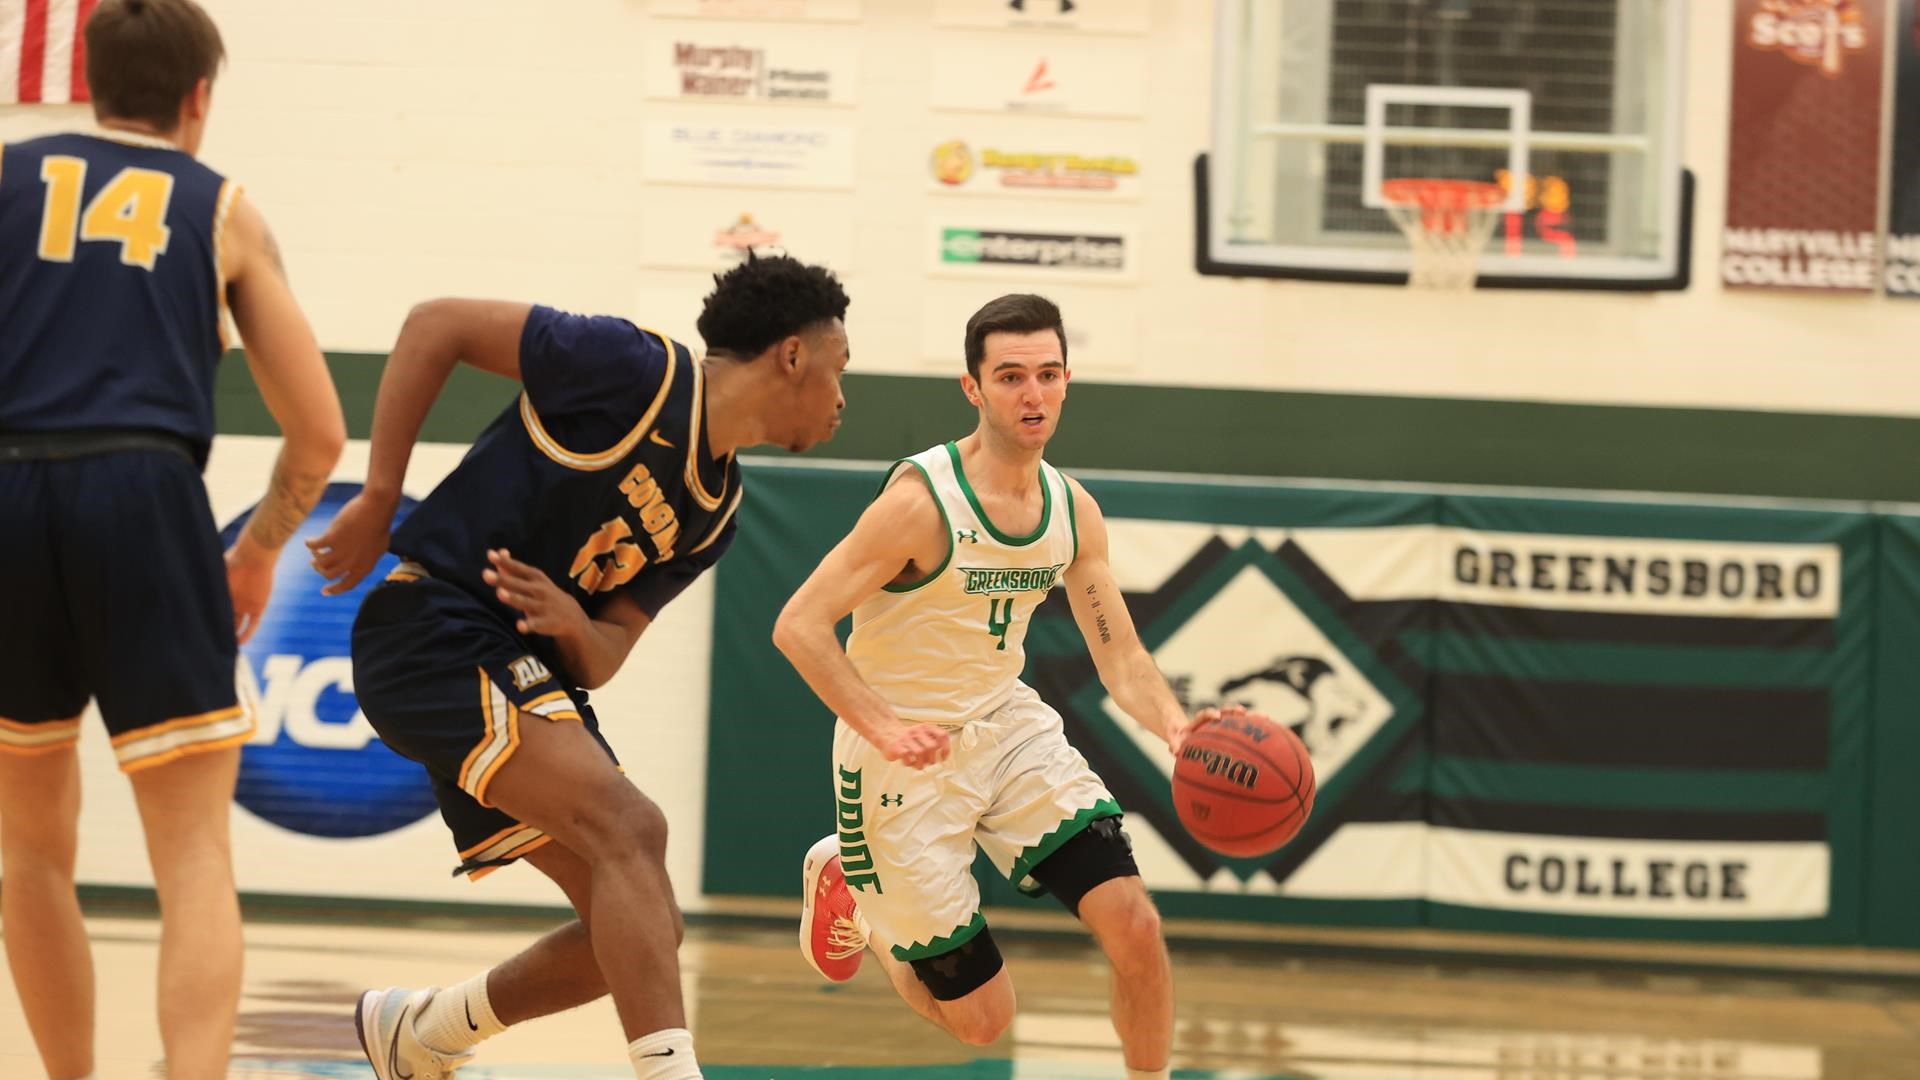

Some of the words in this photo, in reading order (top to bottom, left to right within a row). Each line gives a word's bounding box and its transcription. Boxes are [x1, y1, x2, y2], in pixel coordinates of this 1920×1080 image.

[37, 154, 175, 272] 14
[943, 233, 1123, 268] enterprise
[1723, 255, 1876, 289] COLLEGE
[1454, 546, 1822, 600] GREENSBORO
[988, 598, 1014, 651] 4
[1181, 744, 1259, 791] Wilson
[1504, 853, 1750, 899] COLLEGE
